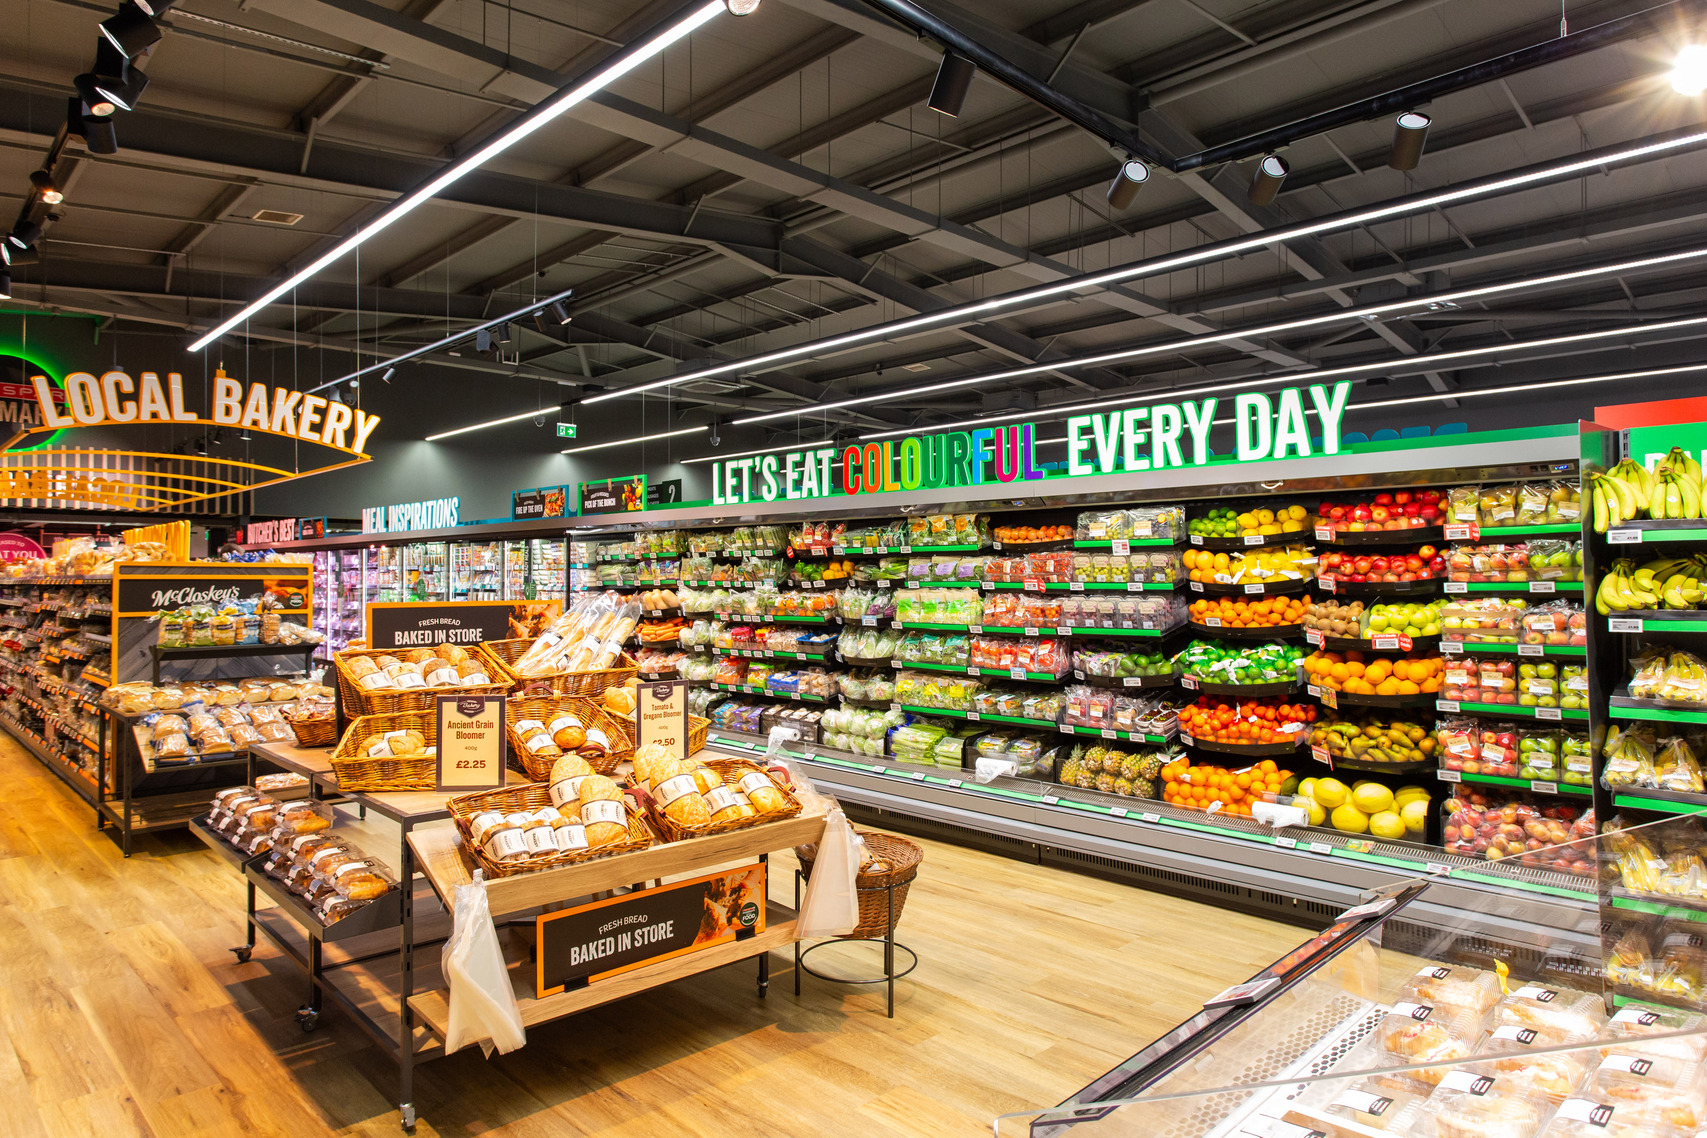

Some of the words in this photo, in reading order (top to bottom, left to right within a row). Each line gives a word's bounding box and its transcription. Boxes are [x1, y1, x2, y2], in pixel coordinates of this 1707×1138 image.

[2, 385, 65, 400] SPR
[30, 371, 198, 428] LOCAL
[211, 376, 381, 454] BAKERY
[1067, 398, 1218, 476] EVERY
[1235, 380, 1352, 461] DAY
[712, 455, 778, 505] LET'S
[786, 449, 835, 499] EAT
[843, 423, 1044, 496] COLOURFUL
[534, 504, 543, 512] OVEN
[584, 499, 593, 508] PICK
[362, 507, 386, 534] MEAL
[389, 497, 459, 532] INSPIRATIONS
[247, 520, 278, 544] BUTCHER'S
[279, 518, 296, 542] BEST
[12, 550, 37, 559] YOU
[151, 585, 240, 607] McCloskey's
[418, 618, 439, 627] FRESH
[439, 617, 461, 626] BREAD
[394, 630, 432, 646] BAKED
[434, 629, 447, 643] IN
[448, 628, 483, 643] STORE
[447, 720, 474, 729] Ancient
[475, 720, 494, 729] Grain
[456, 731, 485, 739] Bloomer
[456, 760, 486, 769] £2.25
[598, 918, 623, 935] FRESH
[624, 914, 648, 924] BREAD
[570, 937, 615, 967] BAKED
[617, 931, 632, 952] IN
[634, 920, 674, 947] STORE
